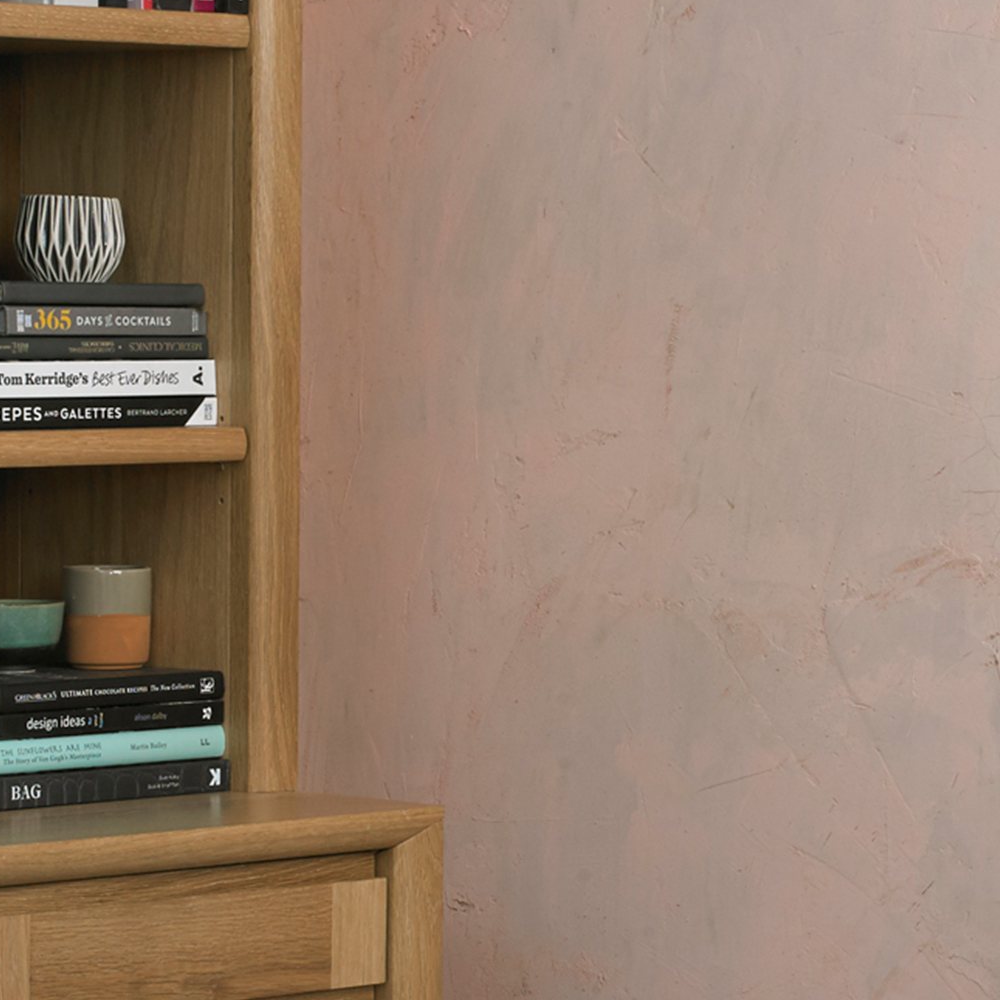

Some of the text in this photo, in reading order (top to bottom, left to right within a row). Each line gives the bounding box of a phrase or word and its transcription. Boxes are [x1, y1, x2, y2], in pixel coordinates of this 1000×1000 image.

[33, 307, 72, 331] 365
[76, 315, 103, 326] DAYS
[115, 315, 172, 327] COCKTAILS
[25, 372, 88, 387] Kerridge's
[92, 373, 114, 387] Best
[117, 372, 142, 386] Ever
[143, 370, 180, 386] Dishes
[60, 407, 122, 420] GALETTES
[127, 408, 188, 416] BERTRAND LARCHER
[60, 688, 93, 699] ULTIMATE
[26, 716, 59, 732] design
[60, 715, 86, 727] ideas
[65, 743, 81, 752] ARE
[11, 784, 42, 801] BAG
